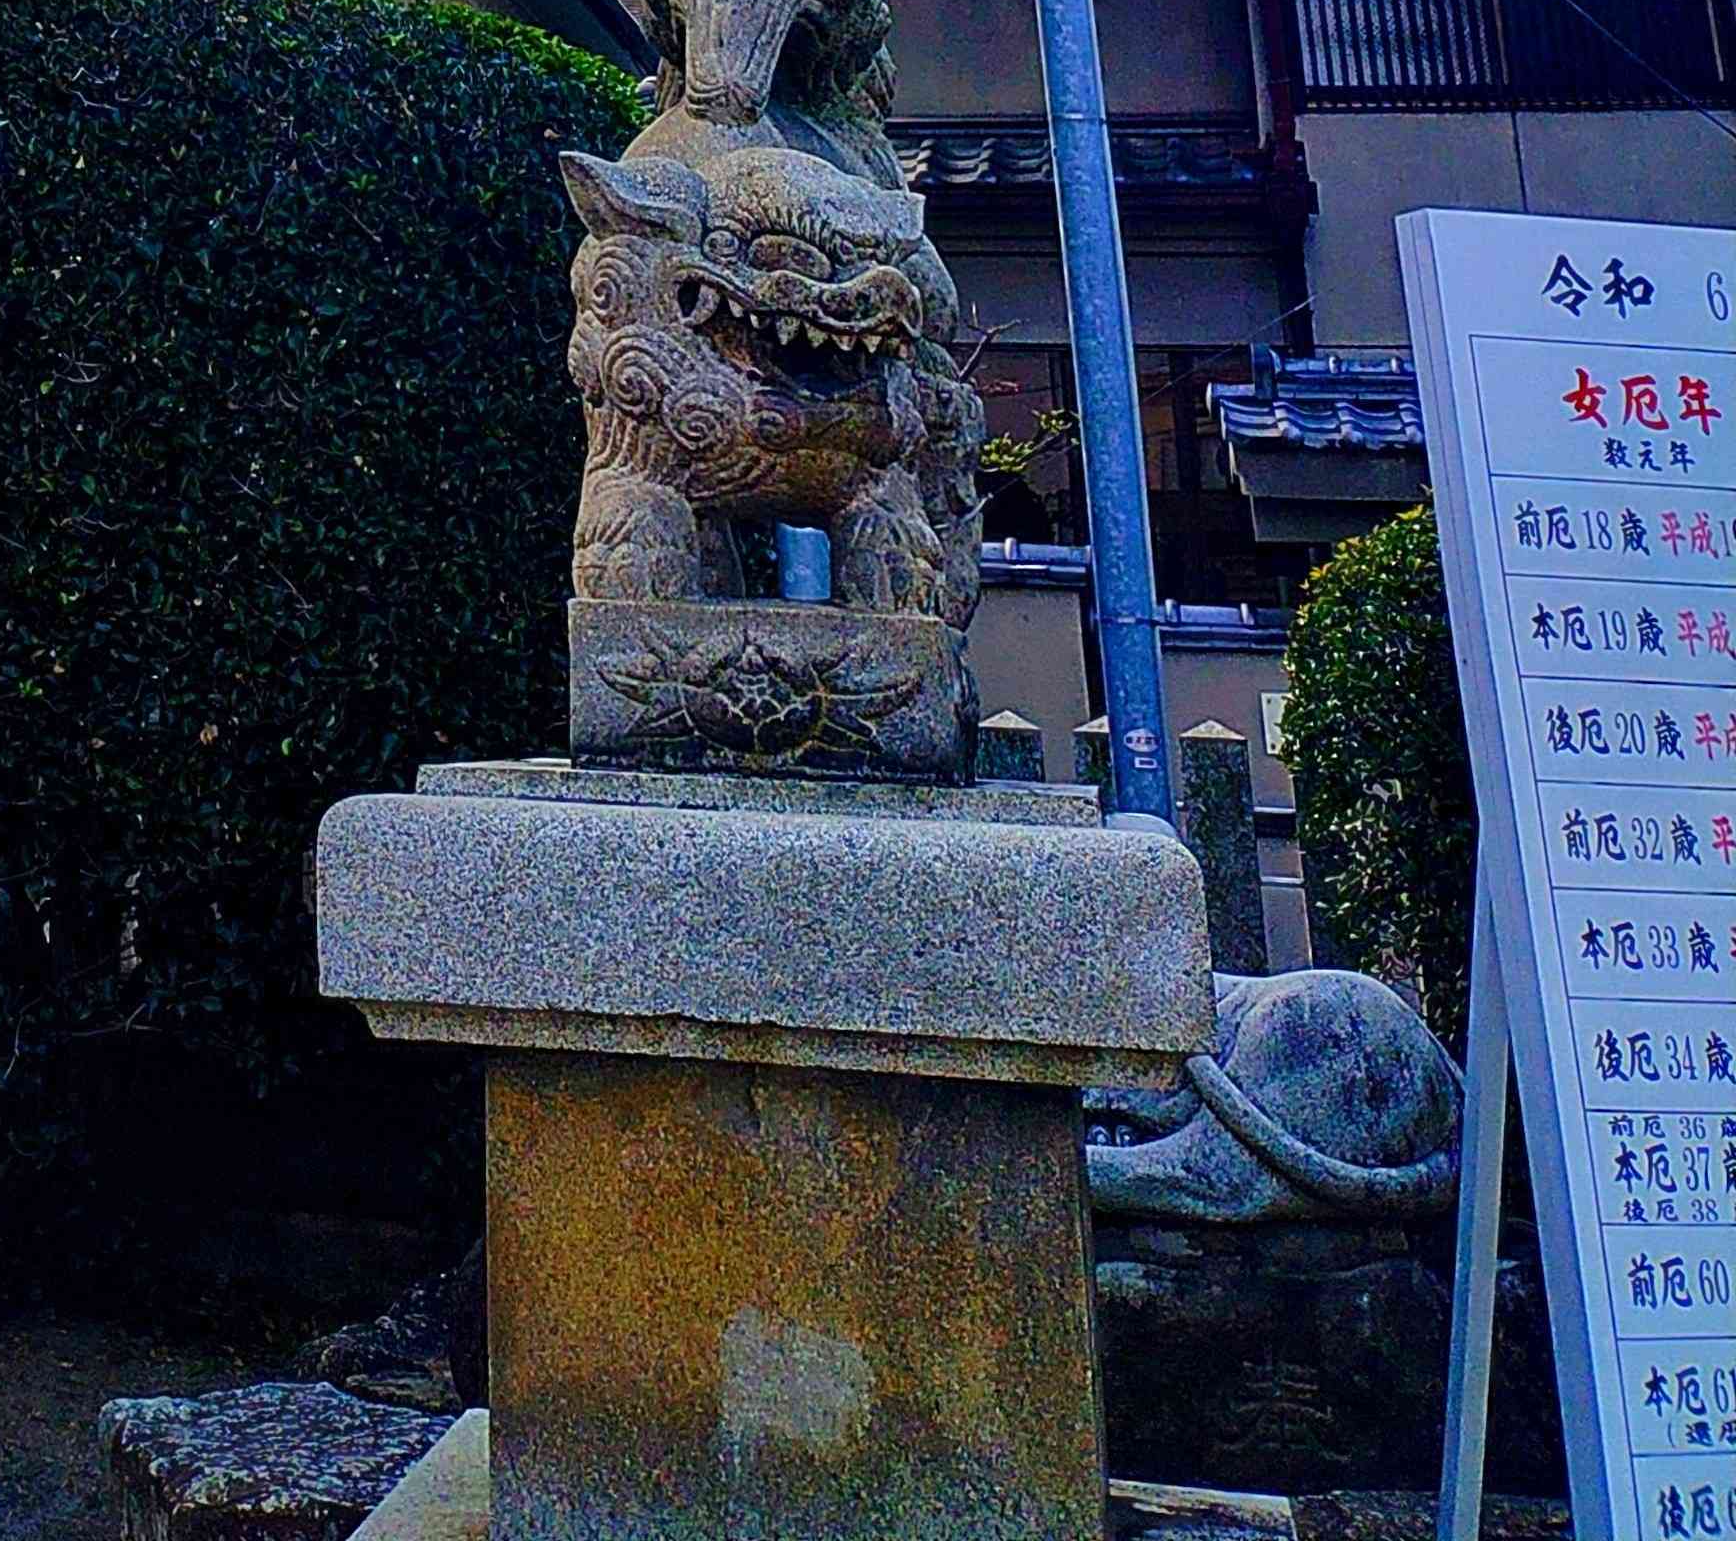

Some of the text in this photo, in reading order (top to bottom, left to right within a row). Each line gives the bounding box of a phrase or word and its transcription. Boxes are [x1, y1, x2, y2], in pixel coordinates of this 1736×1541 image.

[1541, 254, 1728, 321] 令和 6
[1562, 367, 1722, 436] 女厄年
[1603, 436, 1696, 475] 数え年
[1514, 500, 1736, 560] 前厄18歳 平成1
[1531, 602, 1668, 657] 本厄19歳
[1545, 704, 1686, 760] 後厄20歳
[1562, 808, 1702, 865] 前厄32歳
[1580, 918, 1720, 973] 本厄33歳
[1594, 1028, 1736, 1085] 後厄34歳
[1628, 1253, 1730, 1309] 前厄60
